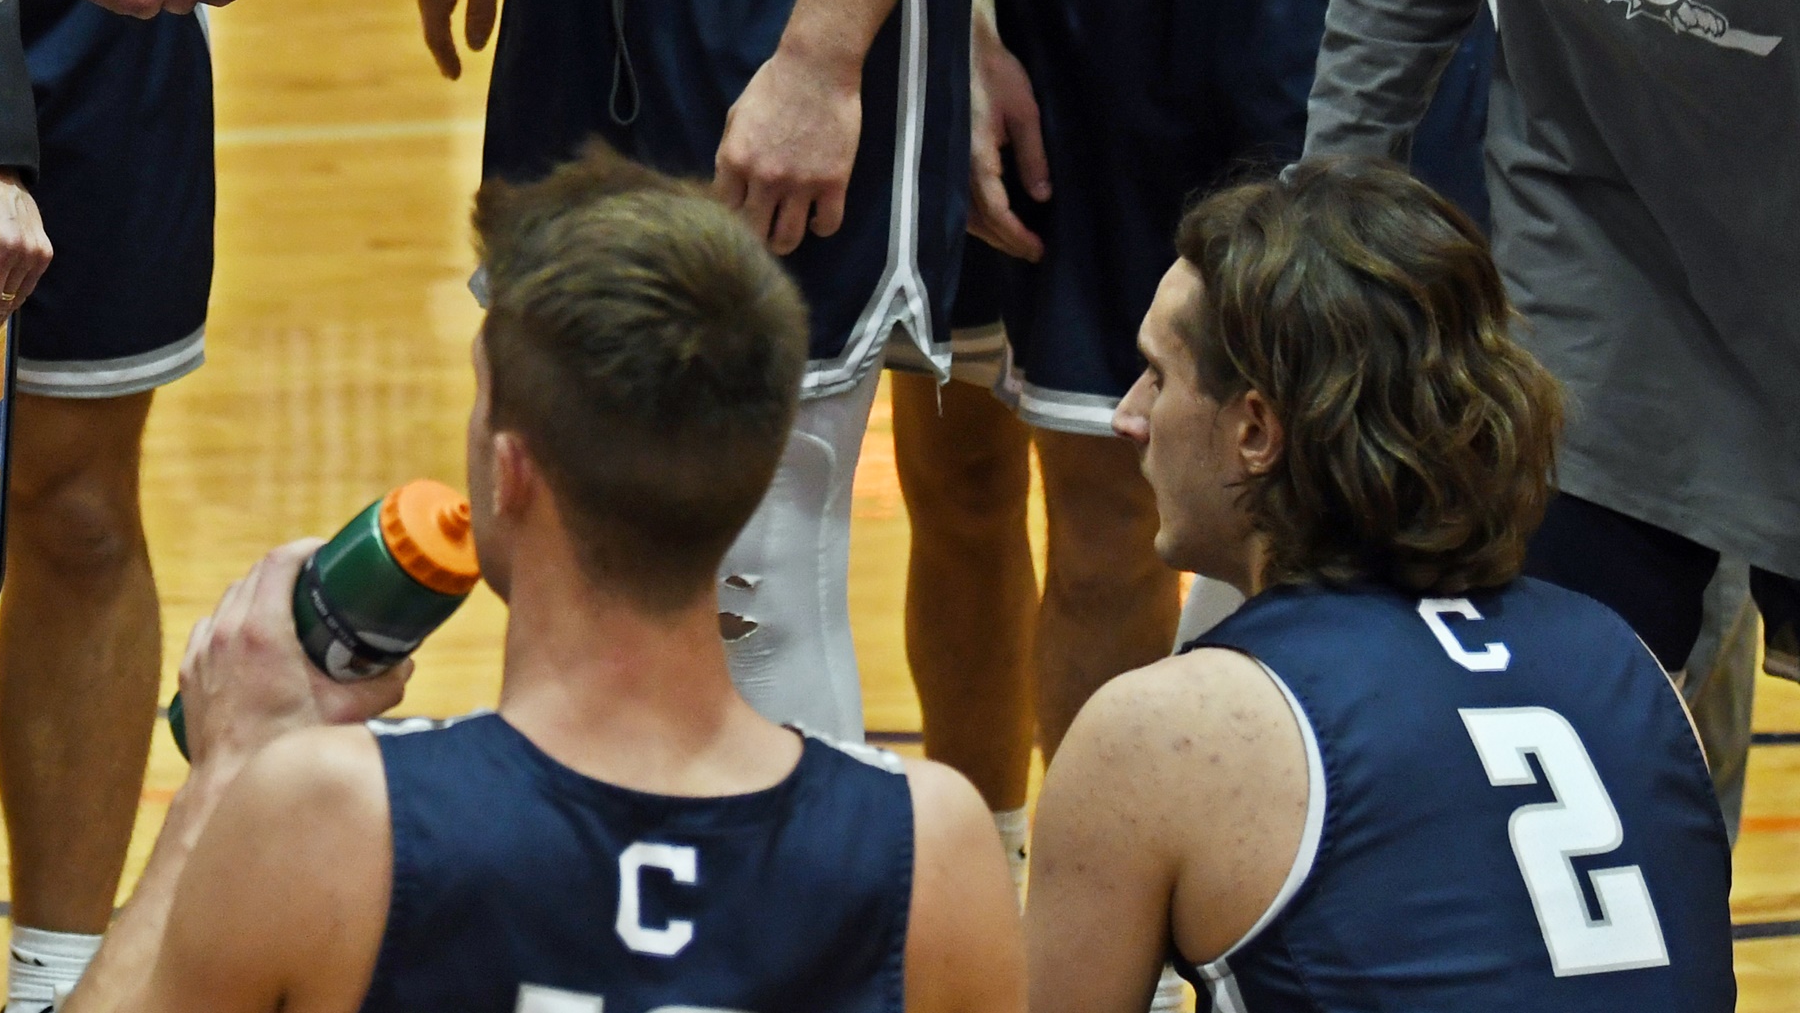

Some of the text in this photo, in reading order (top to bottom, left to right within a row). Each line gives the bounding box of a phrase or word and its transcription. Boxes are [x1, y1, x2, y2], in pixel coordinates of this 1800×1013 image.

[1416, 598, 1511, 672] C
[615, 841, 698, 956] C
[1457, 706, 1670, 978] 2
